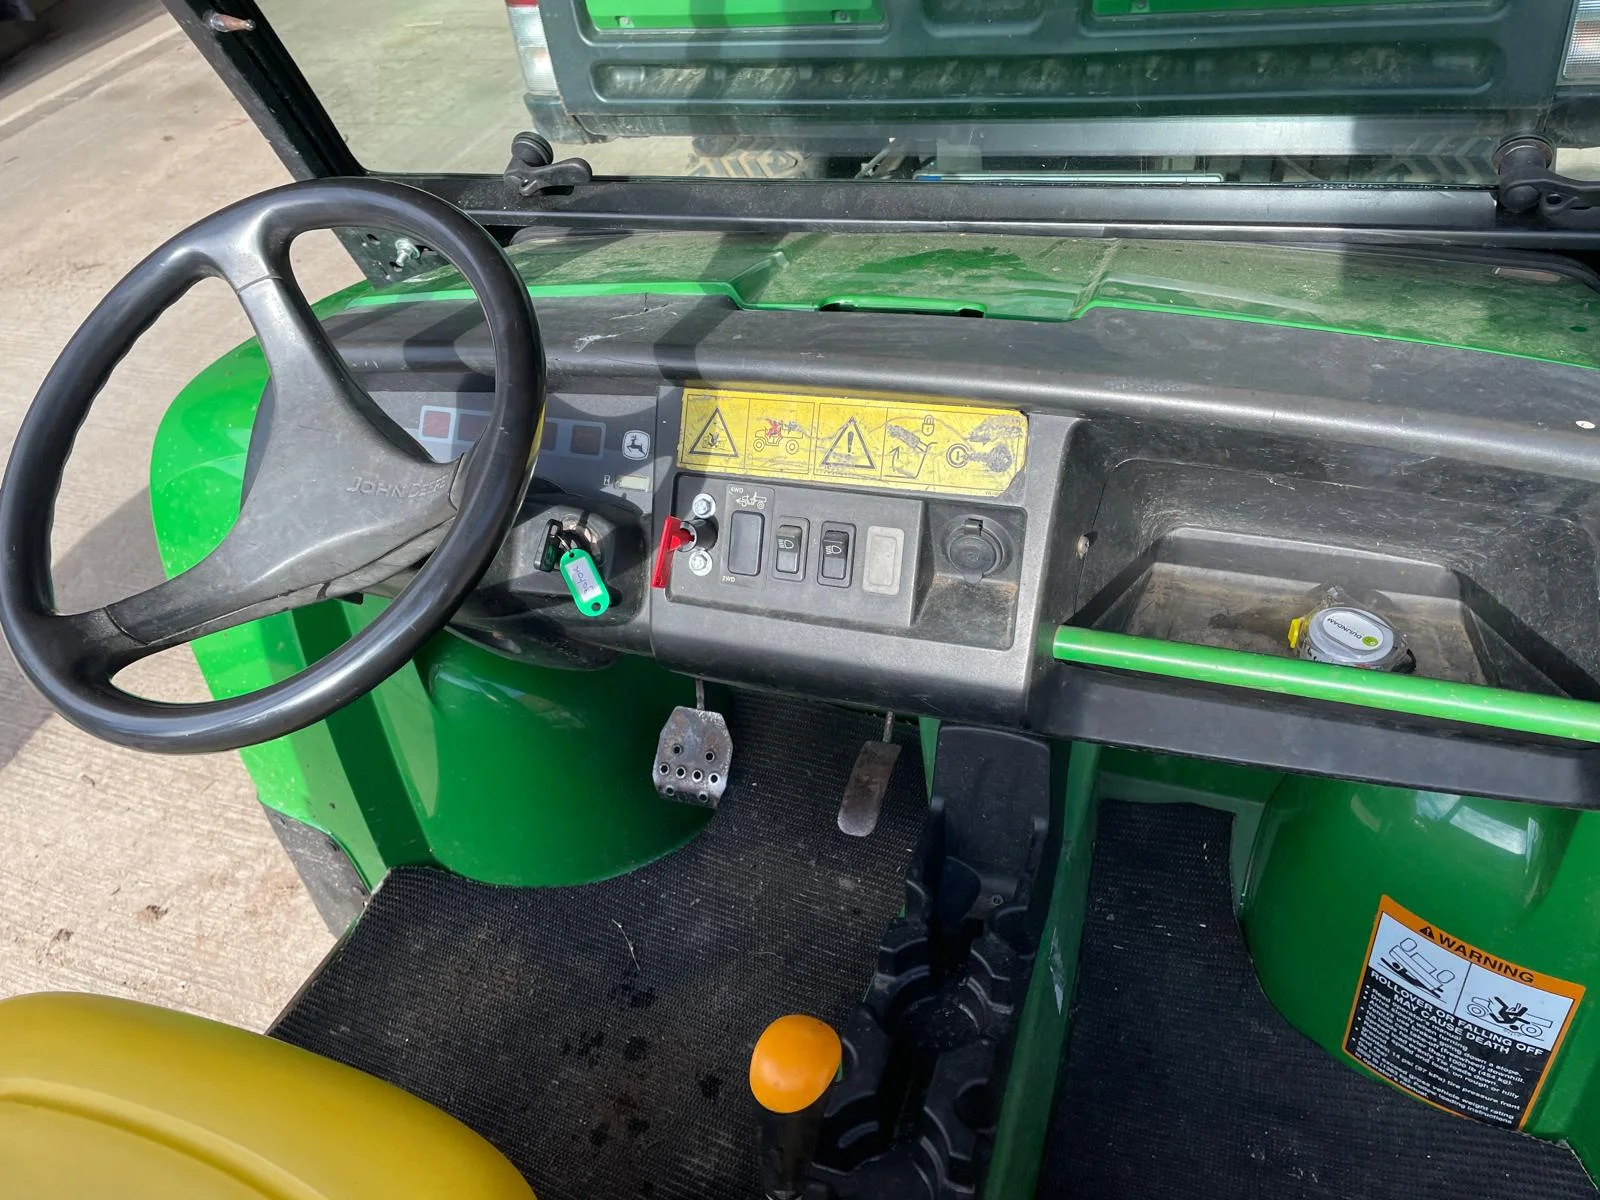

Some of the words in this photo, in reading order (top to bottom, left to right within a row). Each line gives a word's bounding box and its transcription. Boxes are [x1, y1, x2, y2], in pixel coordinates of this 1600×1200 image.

[346, 477, 405, 497] JOHN
[408, 475, 449, 497] DEERE
[1438, 933, 1535, 984] WARNING
[1366, 1009, 1376, 1019] No
[1377, 1017, 1397, 1032] loads
[1398, 1030, 1426, 1048] heavier
[1427, 1047, 1446, 1059] than
[1447, 1057, 1466, 1068] 1000
[1369, 999, 1394, 1018] Always
[1396, 1016, 1409, 1027] use
[1411, 1025, 1437, 1042] brakes
[1438, 1040, 1462, 1054] going
[1463, 1051, 1487, 1064] down
[1495, 1064, 1522, 1077] slope.
[1370, 970, 1433, 1012] ROLLOVER
[1435, 1008, 1454, 1023] OR
[1457, 1019, 1513, 1046] FALLING
[1515, 1042, 1543, 1056] OFF
[1370, 993, 1389, 1008] Drive
[1390, 1006, 1414, 1024] slowly
[1415, 1022, 1437, 1035] when
[1438, 1034, 1468, 1051] turning
[1371, 988, 1390, 1003] Read
[1391, 1001, 1430, 1026] operator's
[1431, 1024, 1461, 1041] manual
[1393, 993, 1418, 1012] MAY
[1420, 1009, 1463, 1035] CAUSE
[1465, 1031, 1510, 1054] DEATH
[1363, 1020, 1390, 1040] Reduce
[1390, 1038, 1414, 1055] speed
[1414, 1052, 1430, 1063] and
[1464, 1076, 1489, 1089] rough
[1501, 1089, 1519, 1099] hilly
[1364, 1014, 1389, 1034] Spread
[1390, 1032, 1407, 1044] load
[1436, 1057, 1447, 1065] Tie
[1449, 1063, 1472, 1076] loads
[1367, 1004, 1393, 1024] Vehicle
[1394, 1022, 1408, 1032] can
[1440, 1047, 1485, 1070] (freewheel)
[1486, 1067, 1525, 1083] downhill.
[1432, 1085, 1460, 1100] vehicle
[1460, 1097, 1489, 1111] weight
[1489, 1108, 1514, 1120] rating
[1446, 1080, 1460, 1089] tire
[1461, 1086, 1498, 1104] pressure
[1499, 1100, 1520, 1110] front
